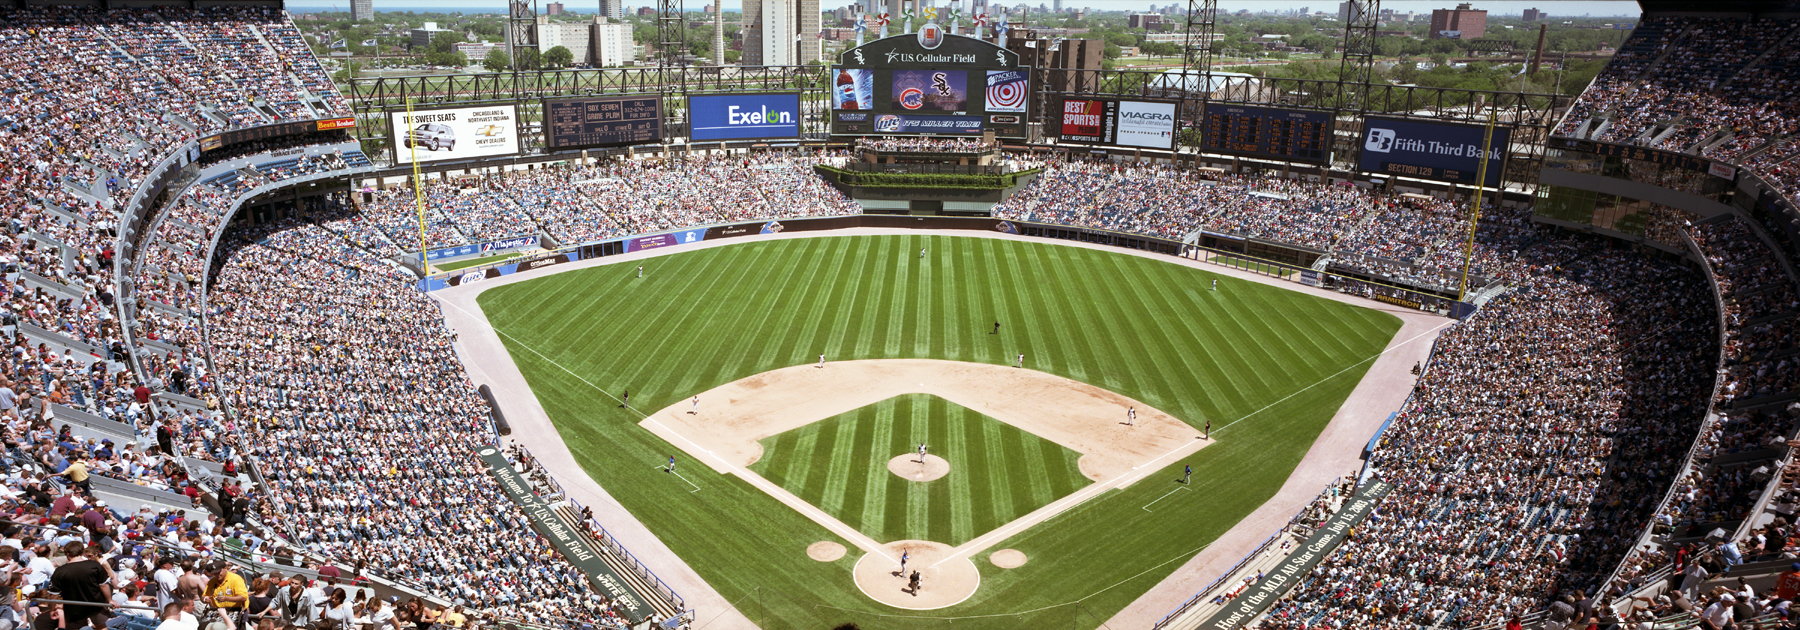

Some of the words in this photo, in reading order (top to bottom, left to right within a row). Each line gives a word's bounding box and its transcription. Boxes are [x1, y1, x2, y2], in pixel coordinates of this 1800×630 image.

[916, 53, 951, 62] Cellular
[953, 54, 976, 63] Field
[995, 71, 1017, 79] PACKER
[728, 104, 790, 124] Exelon
[1064, 102, 1085, 114] BEST
[415, 115, 436, 123] SWEET
[437, 113, 456, 122] SEATS
[1064, 114, 1094, 126] SPORTS
[1121, 111, 1172, 121] VIAGRA
[1395, 138, 1425, 152] Fifth
[1428, 140, 1463, 156] Third
[1466, 145, 1502, 160] Bank
[1388, 163, 1418, 174] SECTION
[1419, 167, 1432, 176] 129
[494, 239, 524, 249] Majestic
[530, 258, 556, 268] OfficeMax
[1377, 294, 1420, 308] ARMITRON
[496, 467, 524, 494] Welcome
[520, 493, 533, 503] To
[543, 518, 570, 542] Cellular
[565, 540, 593, 561] Field
[1214, 611, 1245, 630] Host
[1240, 601, 1254, 613] of
[1248, 591, 1268, 605] the
[1260, 573, 1287, 593] MLB
[1280, 550, 1314, 576] All-Star
[1308, 533, 1337, 553] Game,
[1327, 520, 1350, 534] July
[1349, 500, 1369, 513] 2003
[1785, 578, 1799, 591] 54
[596, 574, 622, 596] WHITE
[618, 595, 638, 612] SOX
